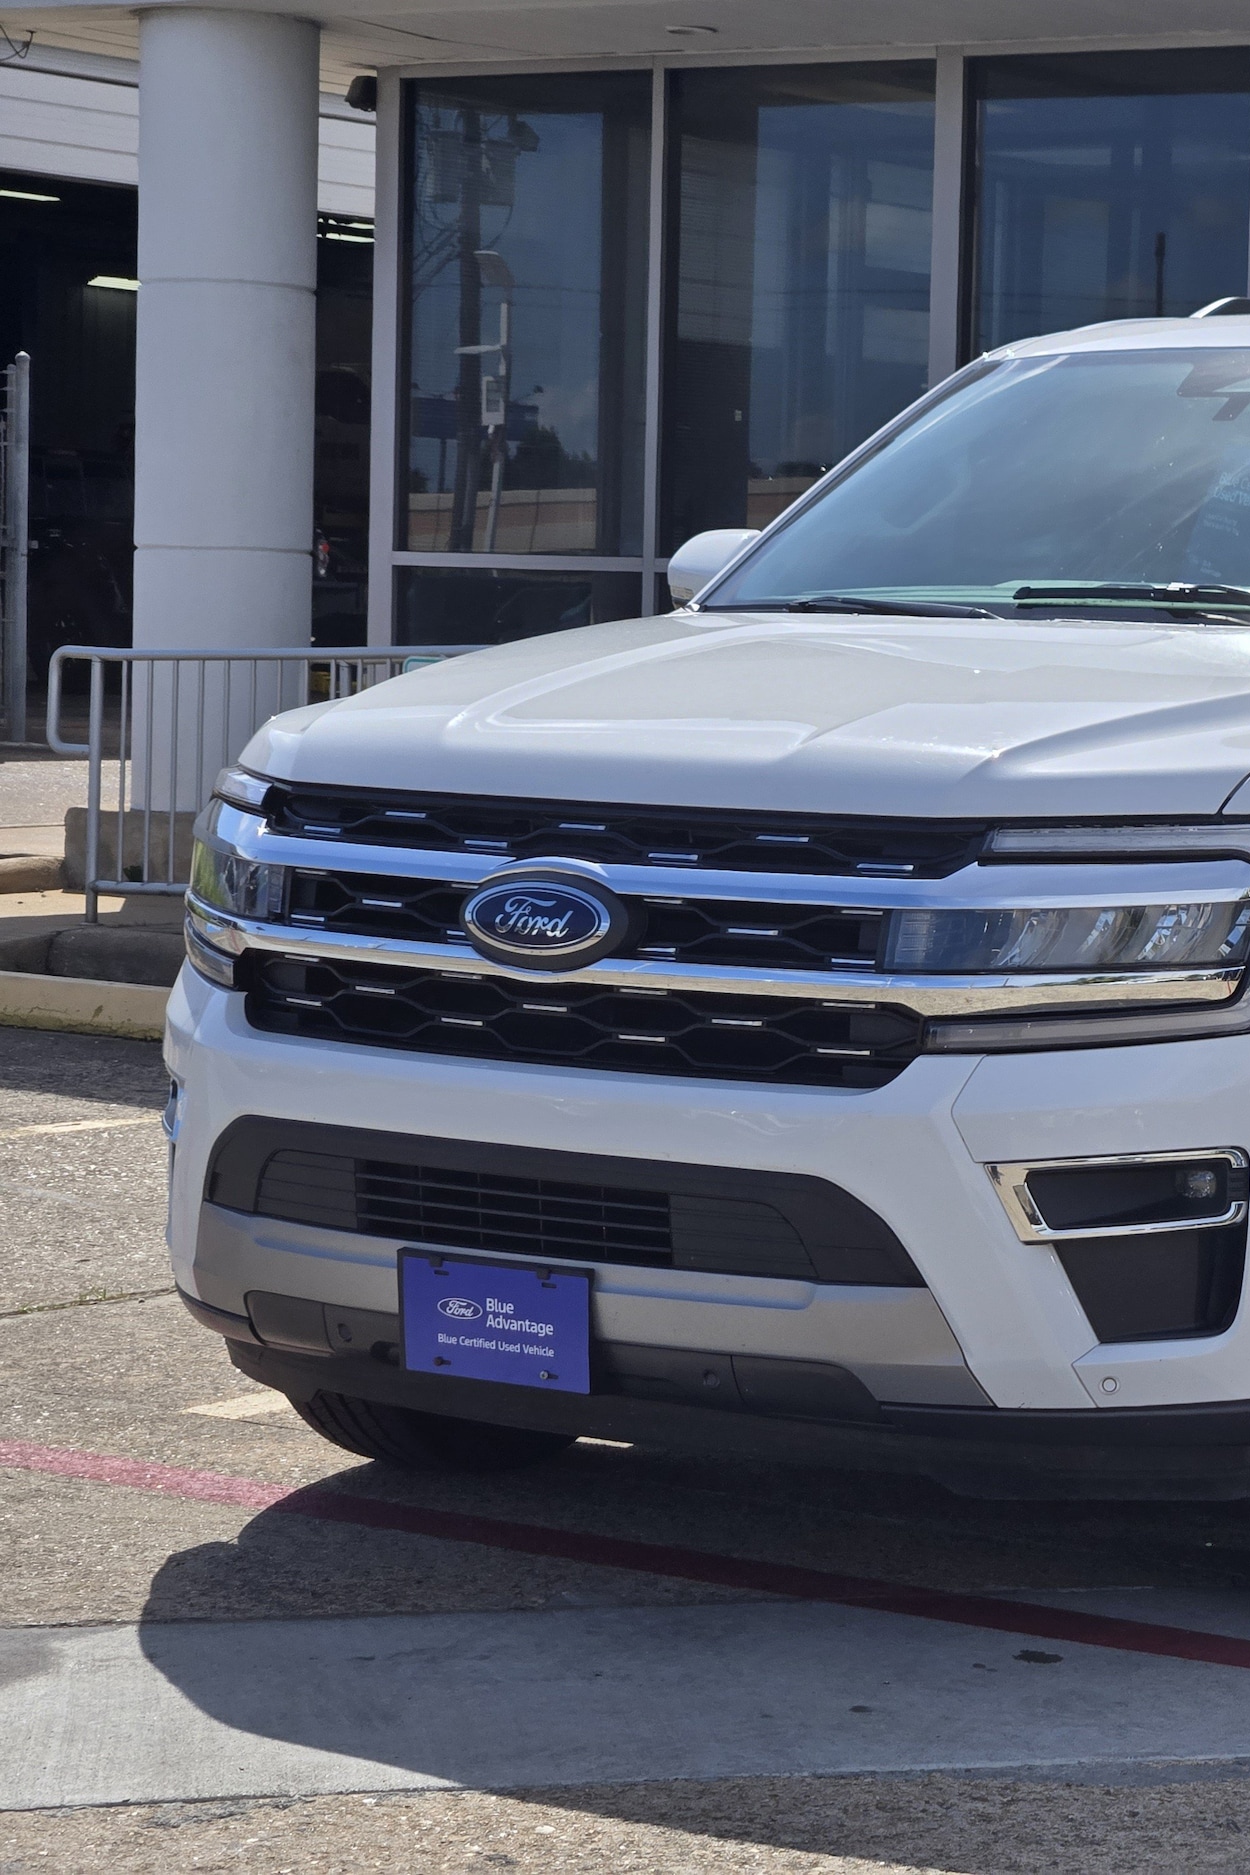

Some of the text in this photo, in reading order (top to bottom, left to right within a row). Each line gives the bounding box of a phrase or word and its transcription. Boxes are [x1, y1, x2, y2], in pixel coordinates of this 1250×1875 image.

[494, 896, 574, 938] Ford
[446, 1300, 474, 1316] Ford
[486, 1298, 514, 1314] Blue
[486, 1314, 554, 1336] Advantage
[437, 1333, 555, 1357] Blue Certified Used Vehicle
